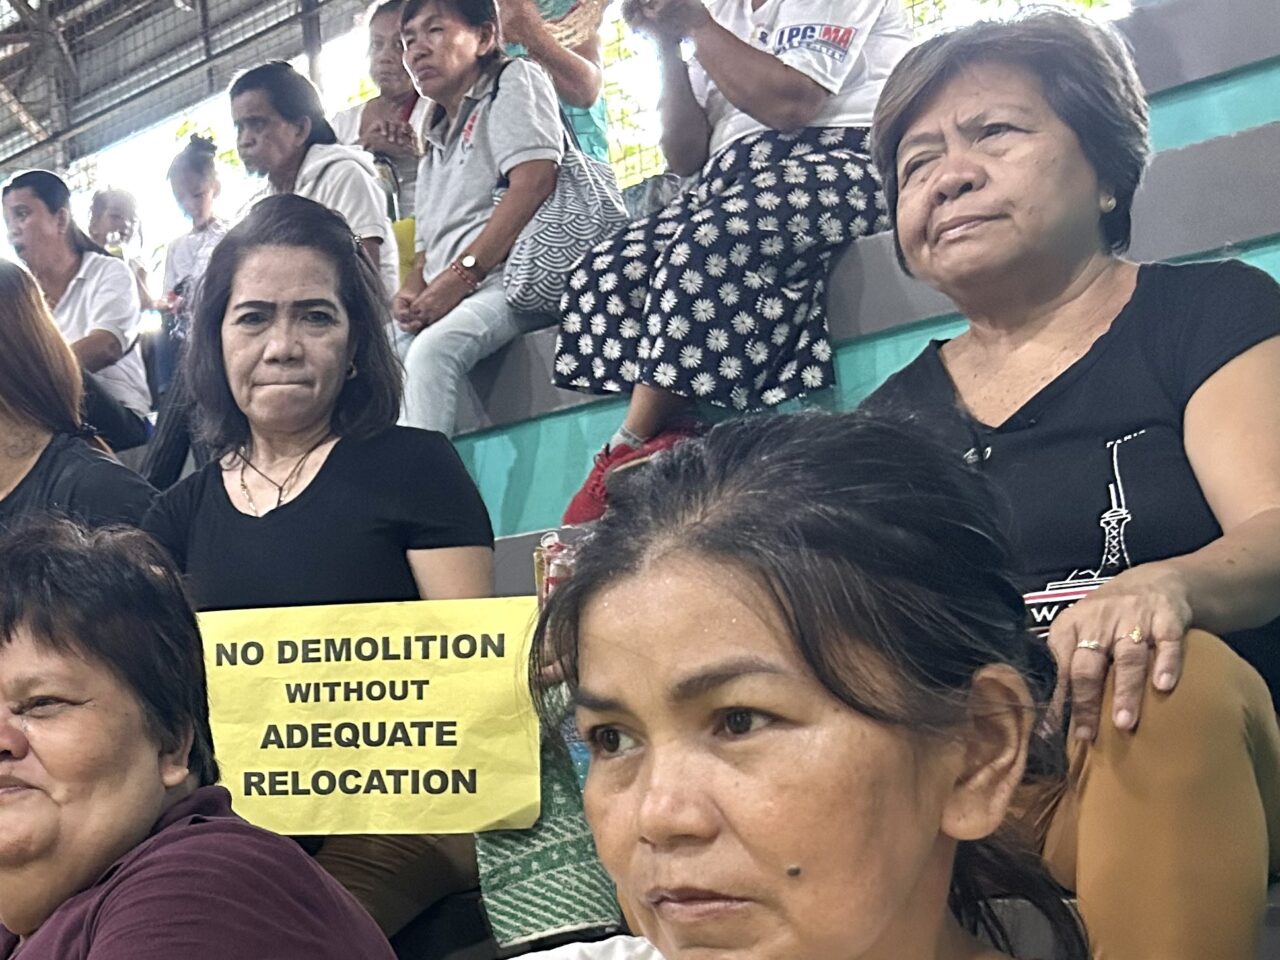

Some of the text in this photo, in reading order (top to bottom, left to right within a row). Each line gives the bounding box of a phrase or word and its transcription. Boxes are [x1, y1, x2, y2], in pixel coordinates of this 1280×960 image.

[215, 633, 505, 667] NO DEMOLITION
[285, 679, 430, 704] WITHOUT
[260, 720, 458, 750] ADEQUATE
[243, 768, 477, 797] RELOCATION
